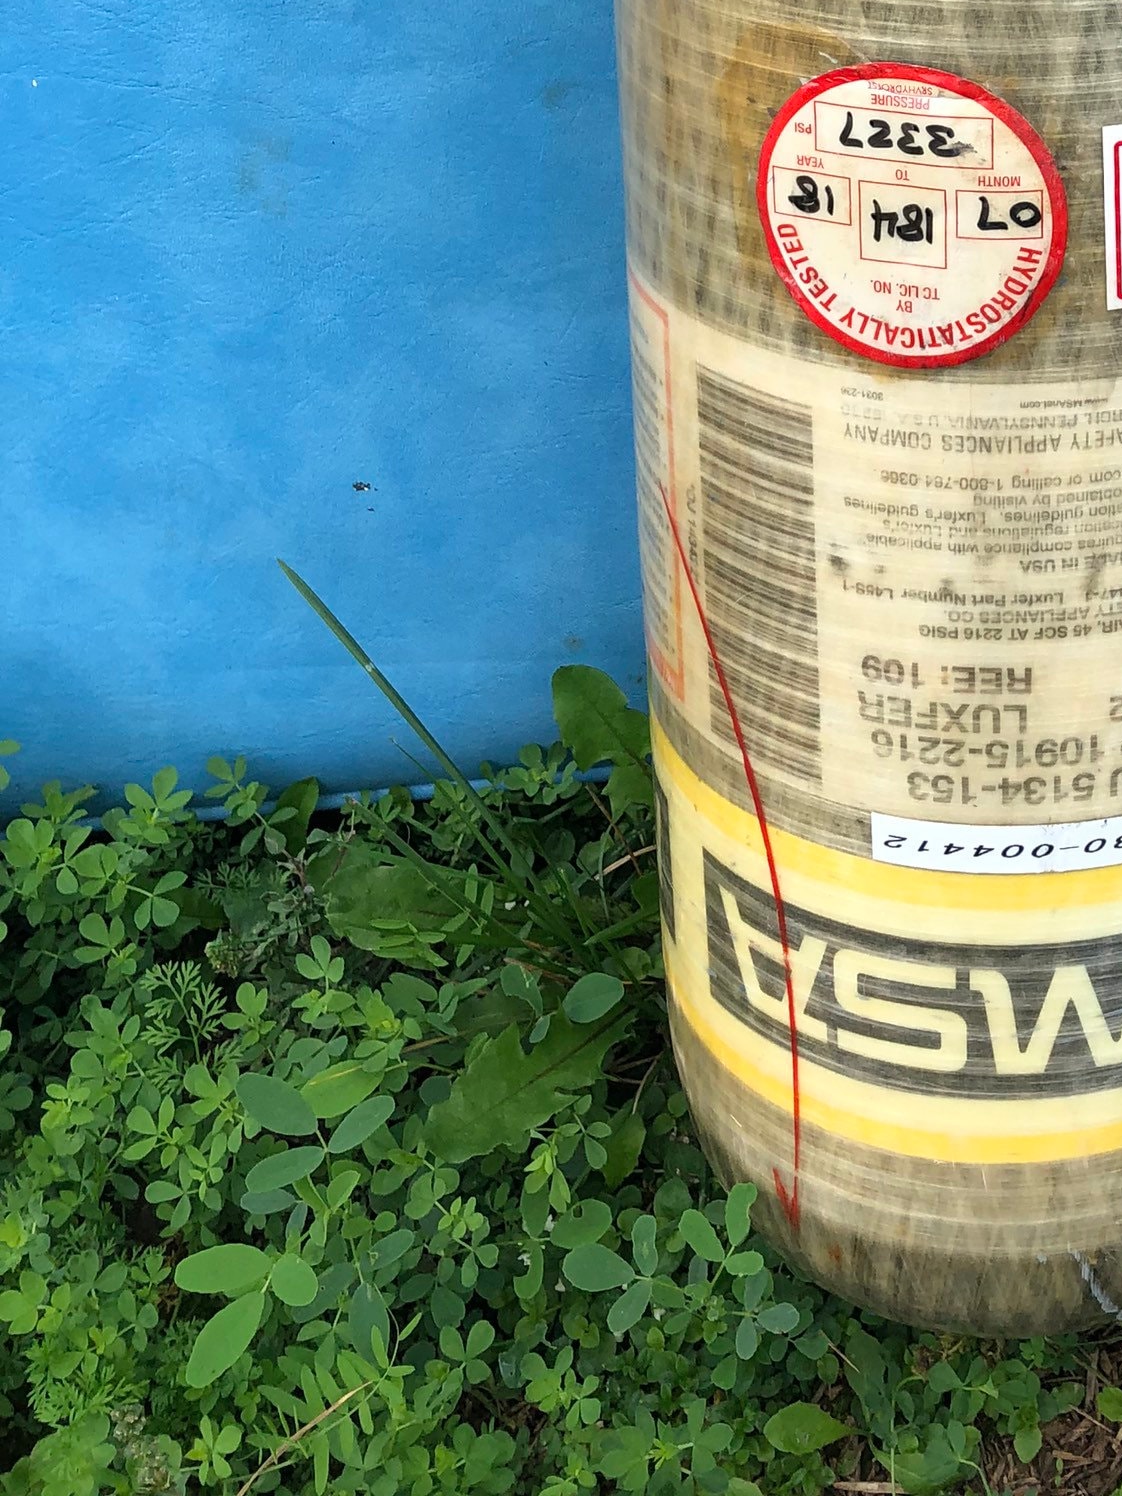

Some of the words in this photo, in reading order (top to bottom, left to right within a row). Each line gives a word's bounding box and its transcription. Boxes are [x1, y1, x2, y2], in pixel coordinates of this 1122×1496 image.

[870, 93, 930, 110] PRESSURE
[794, 122, 812, 134] PSI
[839, 111, 960, 158] 3327
[796, 154, 824, 169] YEAR
[895, 169, 910, 182] TO
[978, 175, 1021, 187] MONTH
[788, 176, 835, 216] 18
[976, 196, 1042, 230] 07
[870, 198, 934, 245] 184
[776, 224, 838, 312] TESTED
[870, 279, 892, 293] NO.
[896, 282, 919, 298] LIC.
[922, 286, 940, 300] TC
[839, 246, 1042, 350] HYDROSTATICALLY
[896, 299, 913, 313] BY
[842, 422, 932, 450] COMPANY
[941, 433, 1061, 454] APPLIANCES
[1011, 474, 1062, 491] calling
[1066, 476, 1082, 487] or
[972, 492, 1028, 508] visiting
[1031, 492, 1051, 506] by
[1056, 486, 1122, 504] obtained
[843, 496, 919, 518] guidelines
[1000, 506, 1084, 524] guidelines.
[924, 509, 986, 524] Luxfer's
[948, 526, 978, 538] and
[866, 532, 943, 552] applicable
[948, 542, 980, 554] with
[983, 539, 1073, 556] compliance
[1018, 558, 1056, 574] USA
[1062, 557, 1079, 570] IN
[900, 588, 966, 604] Number
[971, 593, 1006, 606] Part
[1010, 591, 1064, 606] Luxfer
[943, 610, 974, 624] CO.
[979, 606, 1090, 624] APPLIANCES
[918, 624, 958, 640] PSIG
[963, 626, 1002, 641] 2216
[1008, 627, 1028, 640] AT
[1034, 624, 1068, 640] SCF
[1072, 624, 1092, 638] 45
[860, 654, 926, 690] 109
[940, 665, 1032, 695] REE:
[857, 690, 1028, 734] LUXFER
[870, 728, 1104, 768] 10915-2216
[906, 771, 1096, 806] 5134-153
